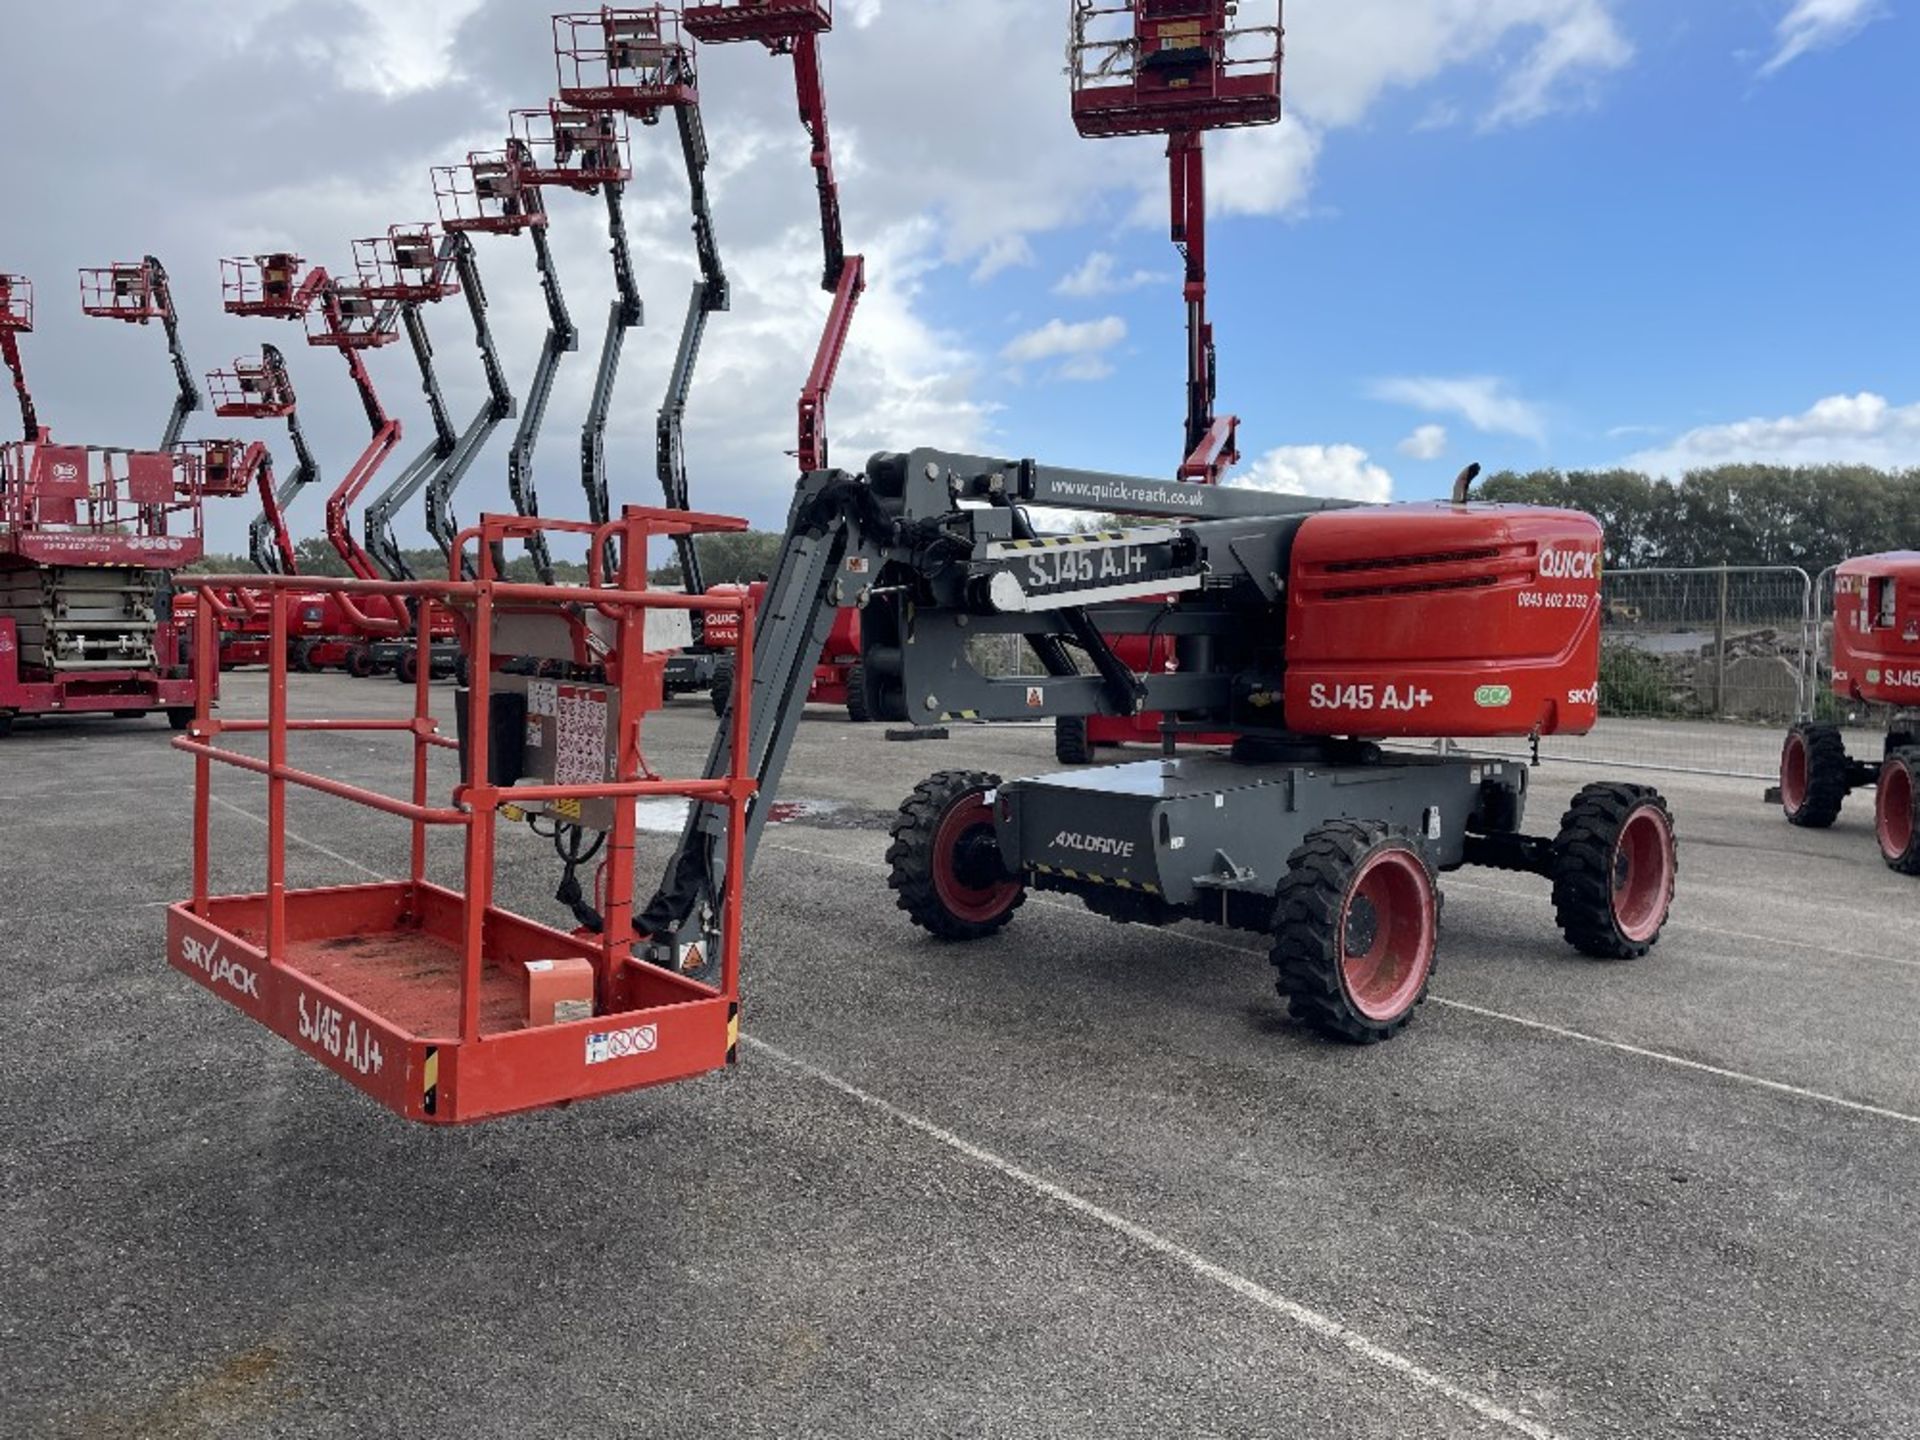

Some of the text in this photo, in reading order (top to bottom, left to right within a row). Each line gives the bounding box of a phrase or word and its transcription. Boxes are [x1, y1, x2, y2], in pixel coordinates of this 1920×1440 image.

[1051, 480, 1204, 507] www.quick-reach.co.uk
[1028, 546, 1147, 587] SJ45 AJ+
[1539, 549, 1597, 579] QUICK
[1518, 591, 1543, 607] 0845
[1544, 592, 1563, 608] 602
[1309, 683, 1433, 711] SJ45 AJ+
[1049, 830, 1135, 858] AXLDRIVE
[181, 935, 260, 999] SKYJACK
[298, 991, 383, 1075] SJ45 AJ+
